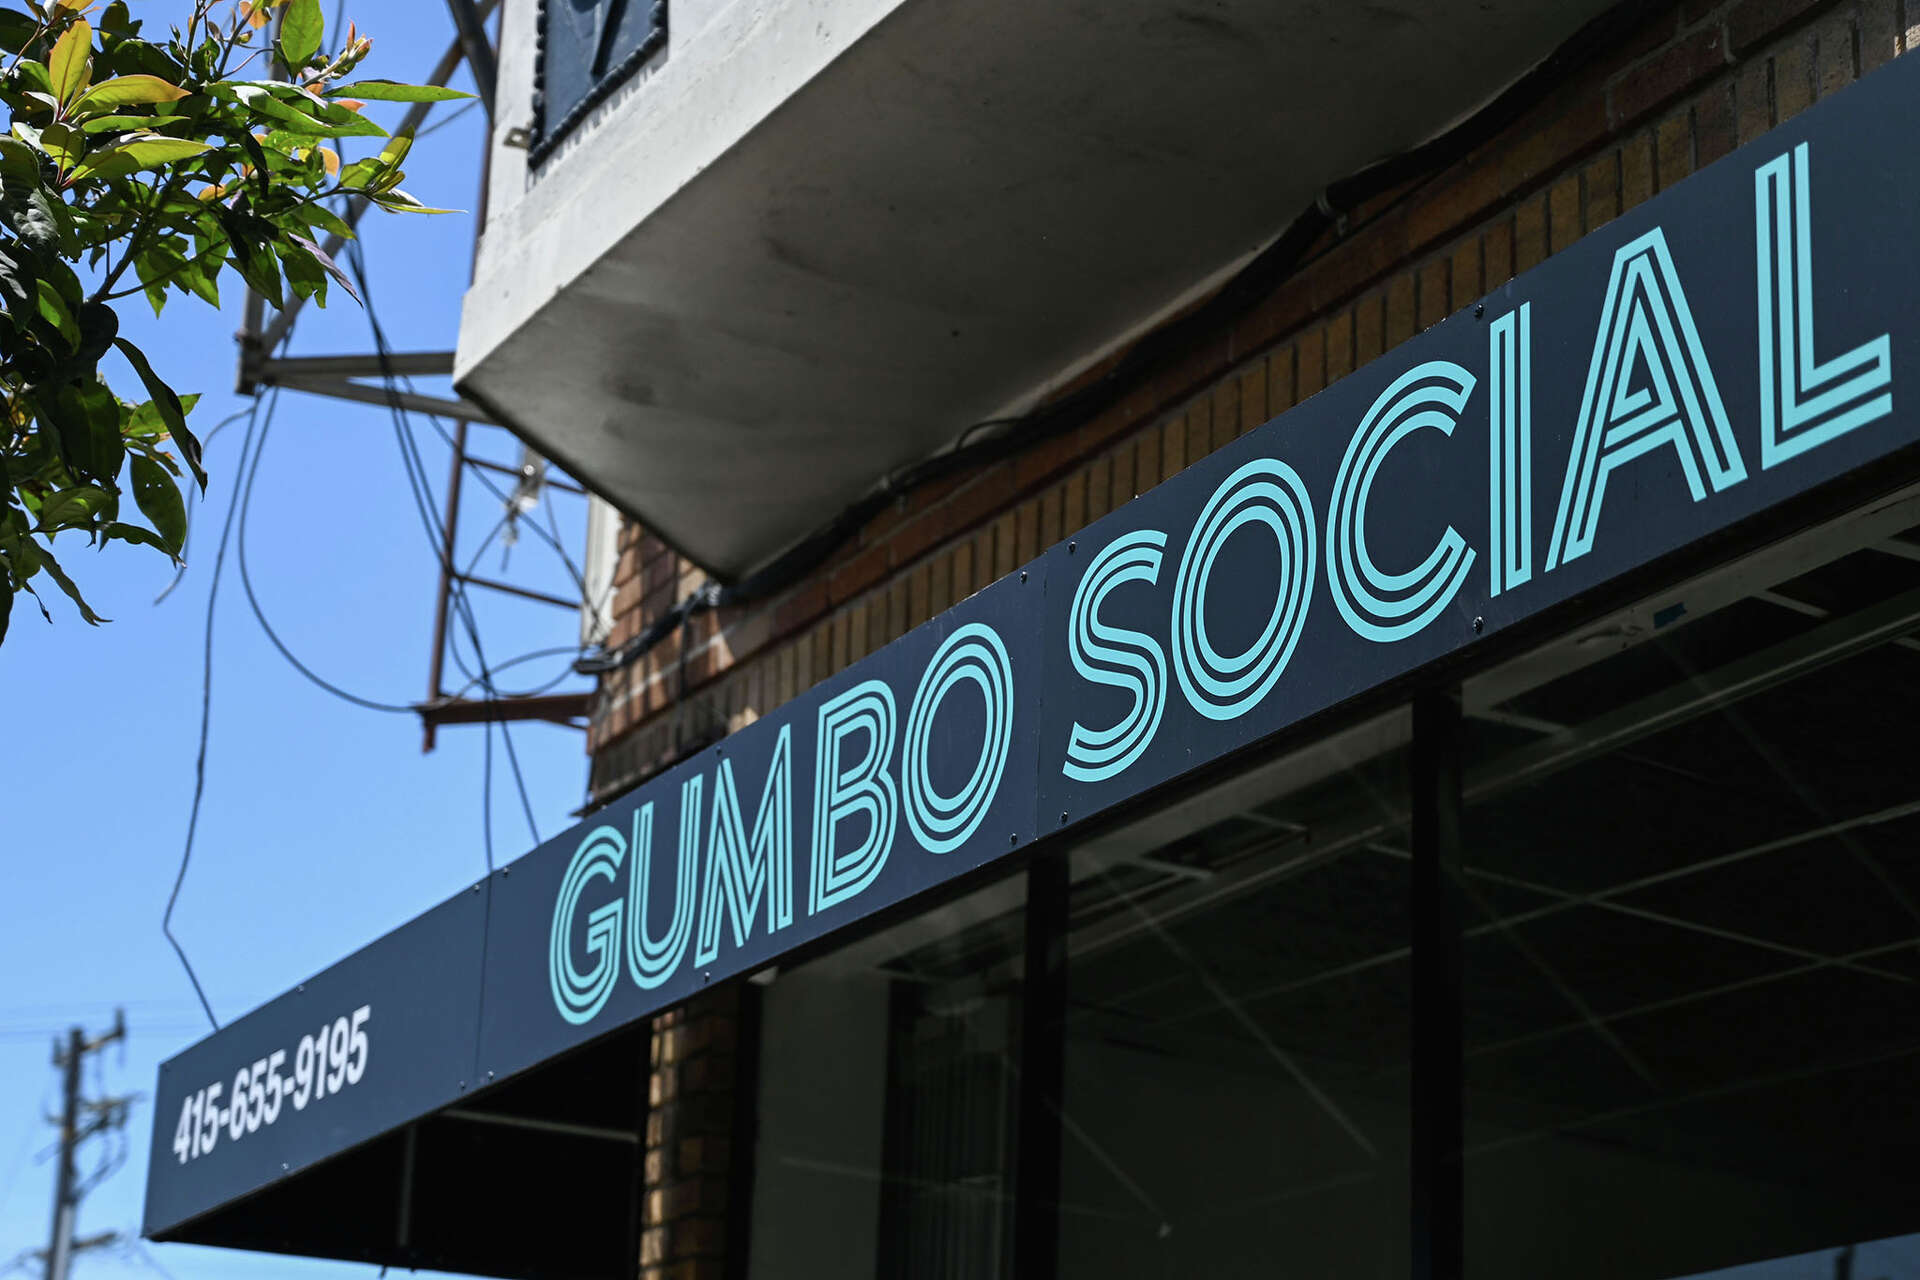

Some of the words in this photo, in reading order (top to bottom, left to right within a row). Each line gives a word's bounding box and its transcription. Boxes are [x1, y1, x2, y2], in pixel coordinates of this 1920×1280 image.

[550, 622, 1014, 1025] GUMBO
[1063, 141, 1893, 782] SOCIAL
[173, 1004, 371, 1164] 415-655-9195
